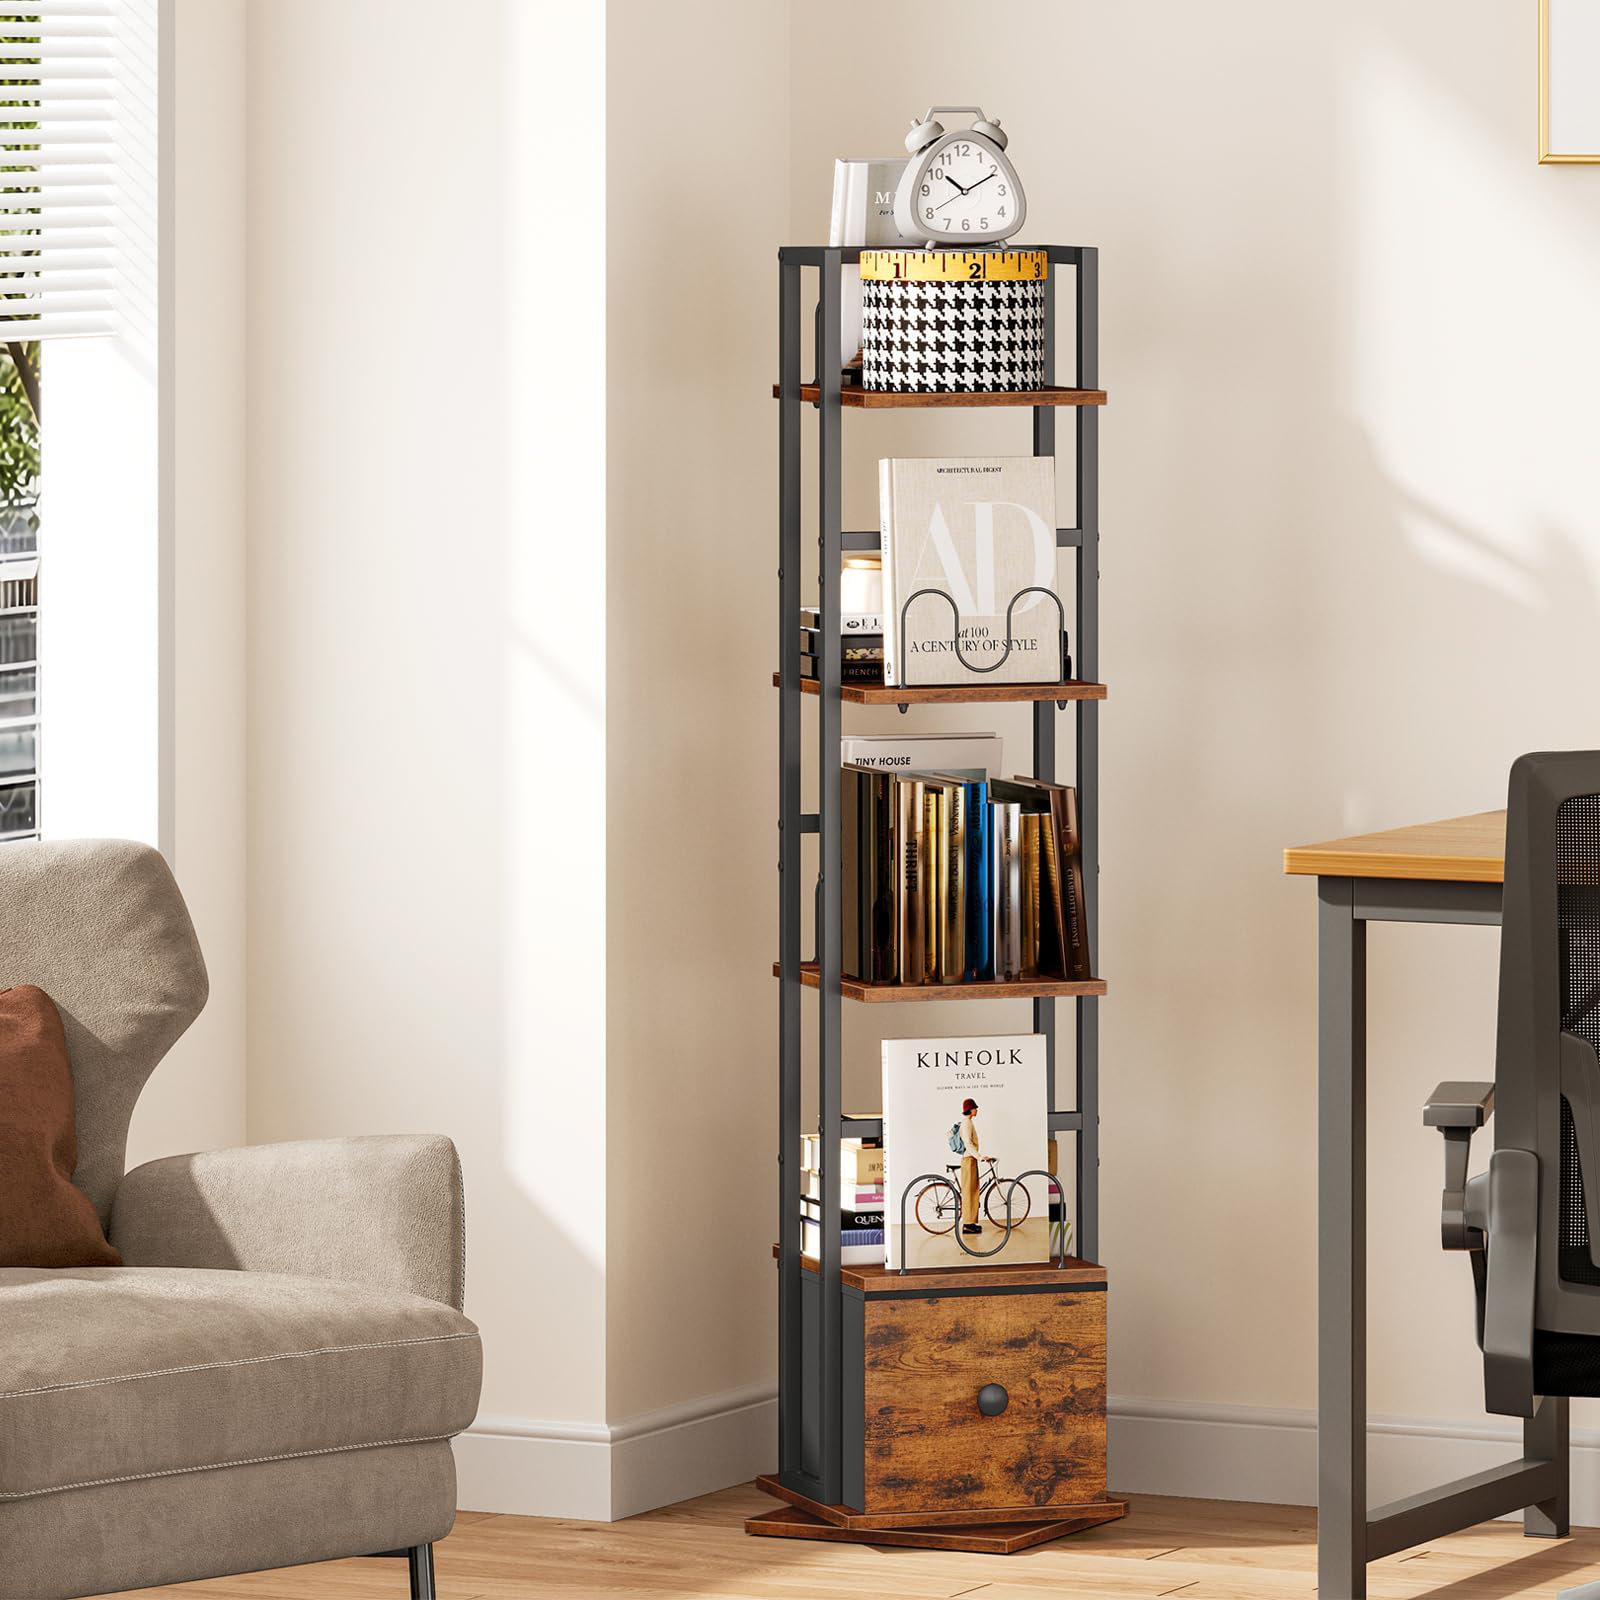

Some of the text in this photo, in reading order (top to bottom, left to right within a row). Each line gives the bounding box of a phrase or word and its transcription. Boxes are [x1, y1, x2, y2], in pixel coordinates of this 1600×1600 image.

[954, 144, 970, 157] 12
[939, 153, 951, 165] 11
[976, 152, 983, 164] 1
[928, 168, 944, 180] 10
[990, 164, 998, 176] 2
[921, 184, 930, 197] 9
[998, 184, 1006, 196] 3
[926, 207, 934, 219] 8
[997, 206, 1006, 217] 4
[943, 218, 952, 230] 7
[961, 219, 970, 231] 6
[980, 217, 989, 230] 5
[893, 262, 1041, 279] 1 2 3
[900, 501, 1057, 618] AD
[957, 626, 989, 639] at 100
[910, 638, 1038, 653] A CENTURY OF STYLE
[855, 756, 911, 766] TINY HOUSE
[905, 839, 918, 893] THRIFT
[1066, 867, 1077, 916] CHARLOTTE
[917, 1048, 1023, 1068] KINFOLK
[955, 1072, 986, 1080] TRAVEL
[854, 1215, 885, 1225] QUEN
